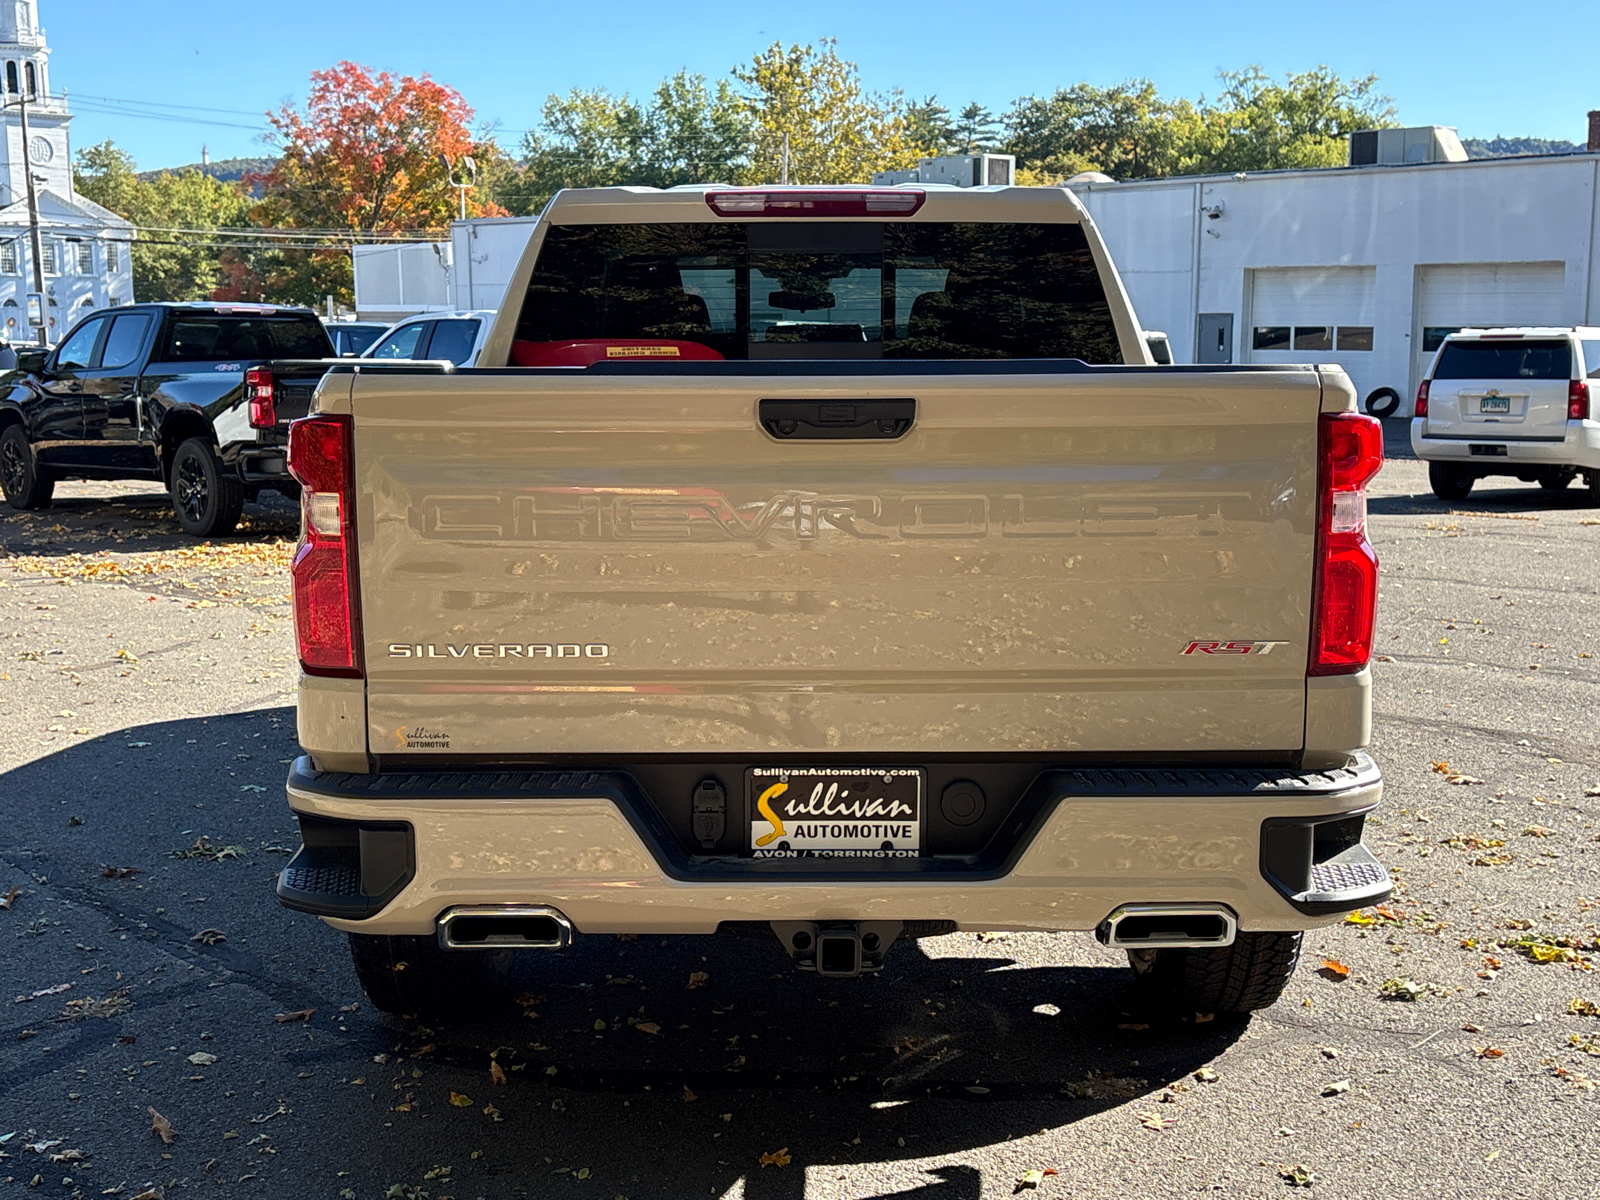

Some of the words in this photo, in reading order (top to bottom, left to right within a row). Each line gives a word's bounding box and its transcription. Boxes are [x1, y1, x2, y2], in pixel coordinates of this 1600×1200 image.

[421, 492, 1252, 540] CHEVROLET
[387, 643, 610, 659] SILVERADO
[1178, 640, 1291, 655] RST
[396, 725, 450, 748] Sullivan
[406, 741, 450, 749] AUTOMOTIVE
[753, 768, 920, 777] SullivanAutomotive.com
[755, 782, 913, 847] Sullivan
[793, 825, 912, 838] AUTOMOTIVE
[753, 850, 798, 858] AVON
[811, 850, 920, 858] TORRINGTON
